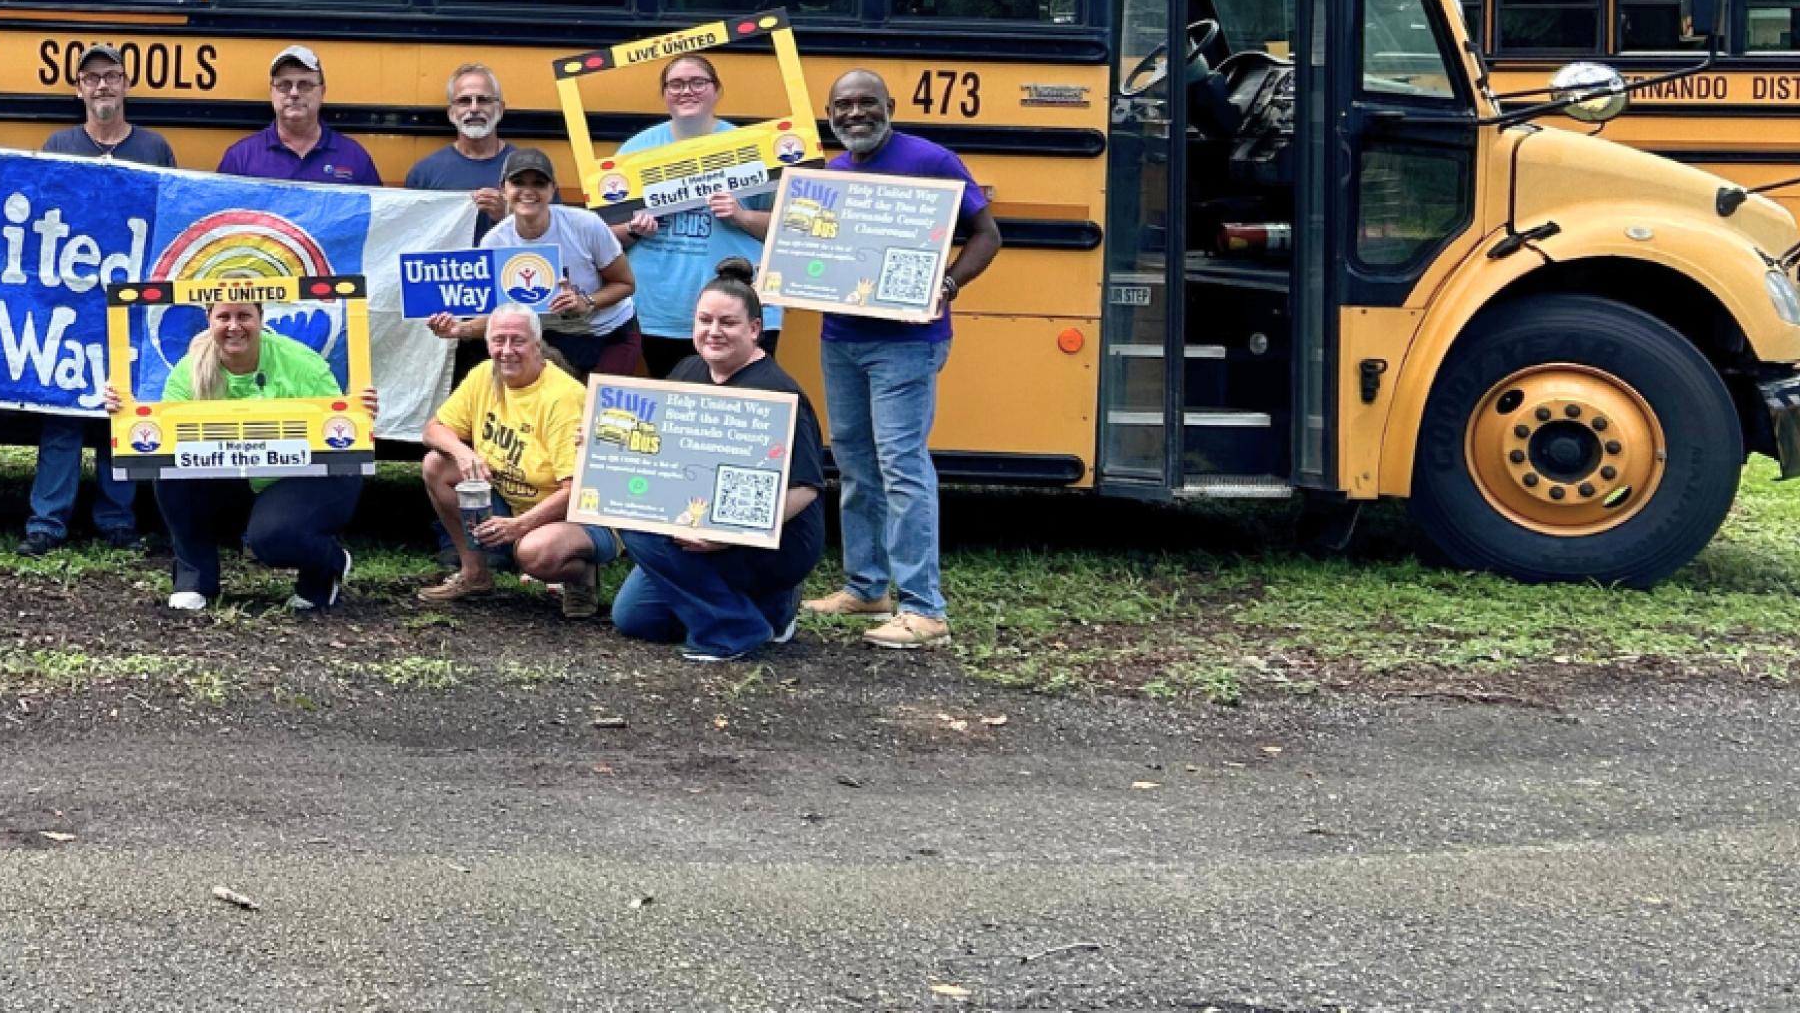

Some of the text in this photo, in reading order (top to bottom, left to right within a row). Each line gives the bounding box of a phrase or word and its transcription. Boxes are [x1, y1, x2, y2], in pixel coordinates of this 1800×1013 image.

[627, 32, 717, 63] LIVE UNITED
[38, 39, 217, 90] SCOOLS
[912, 69, 981, 118] 473
[649, 169, 766, 207] Stuff the Bus!
[791, 177, 840, 209] Stuff
[404, 256, 491, 283] United
[188, 286, 287, 302] LIVE UNITED
[438, 284, 491, 311] Way
[601, 386, 657, 422] Stuff
[666, 394, 770, 418] Help United Way
[180, 450, 306, 467] Stuff the Bus!
